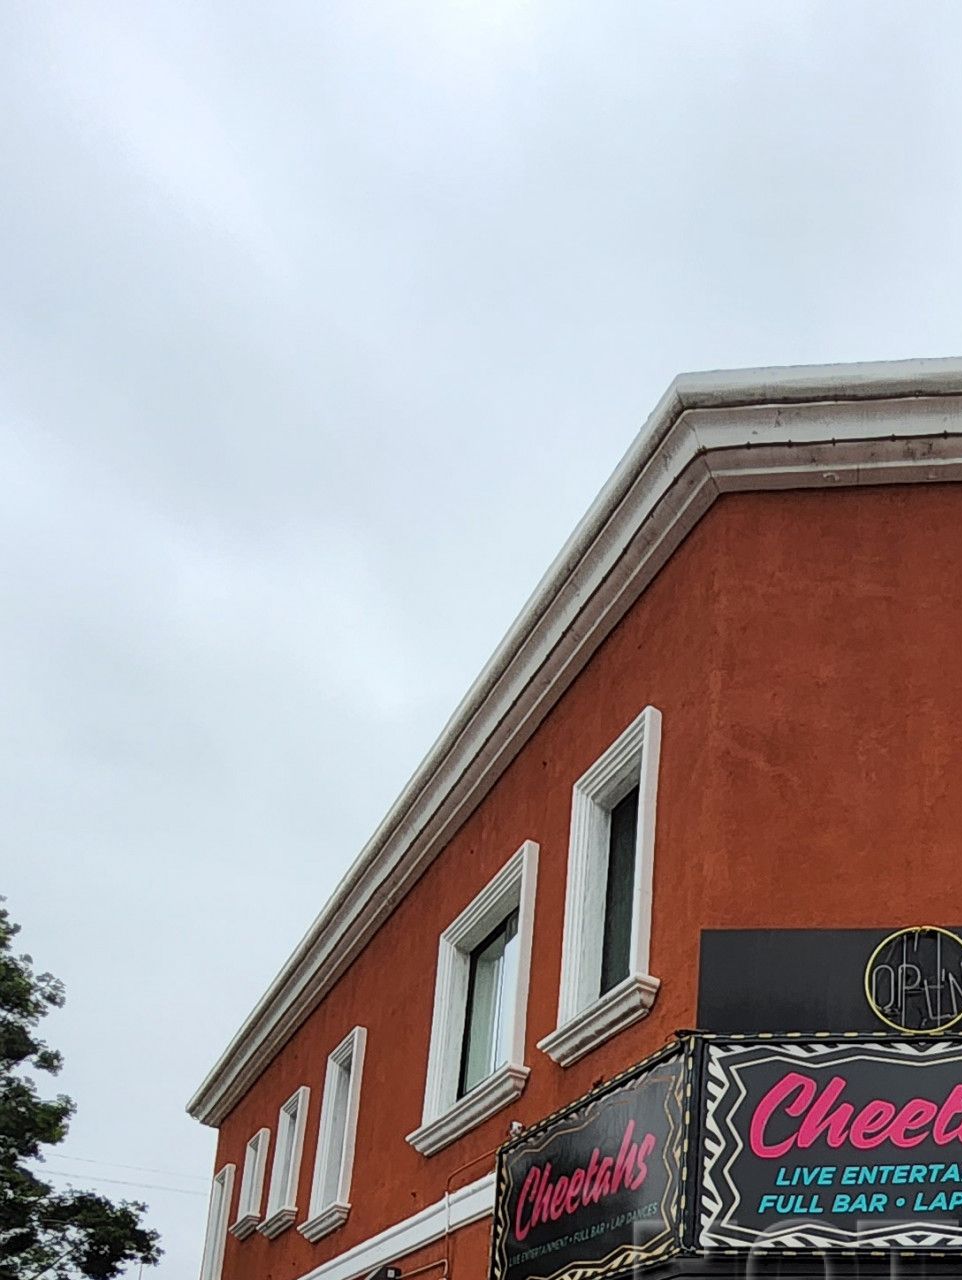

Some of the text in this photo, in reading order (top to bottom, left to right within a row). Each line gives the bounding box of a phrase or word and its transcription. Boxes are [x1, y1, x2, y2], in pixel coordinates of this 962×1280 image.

[514, 1119, 656, 1241] Cheetahs
[775, 1166, 837, 1186] LIVE
[757, 1193, 824, 1214] FULL
[831, 1193, 888, 1213] BAR
[573, 1228, 589, 1243] FULL
[590, 1222, 605, 1238] BAR
[610, 1214, 626, 1230] LAP
[626, 1203, 658, 1224] DANCES
